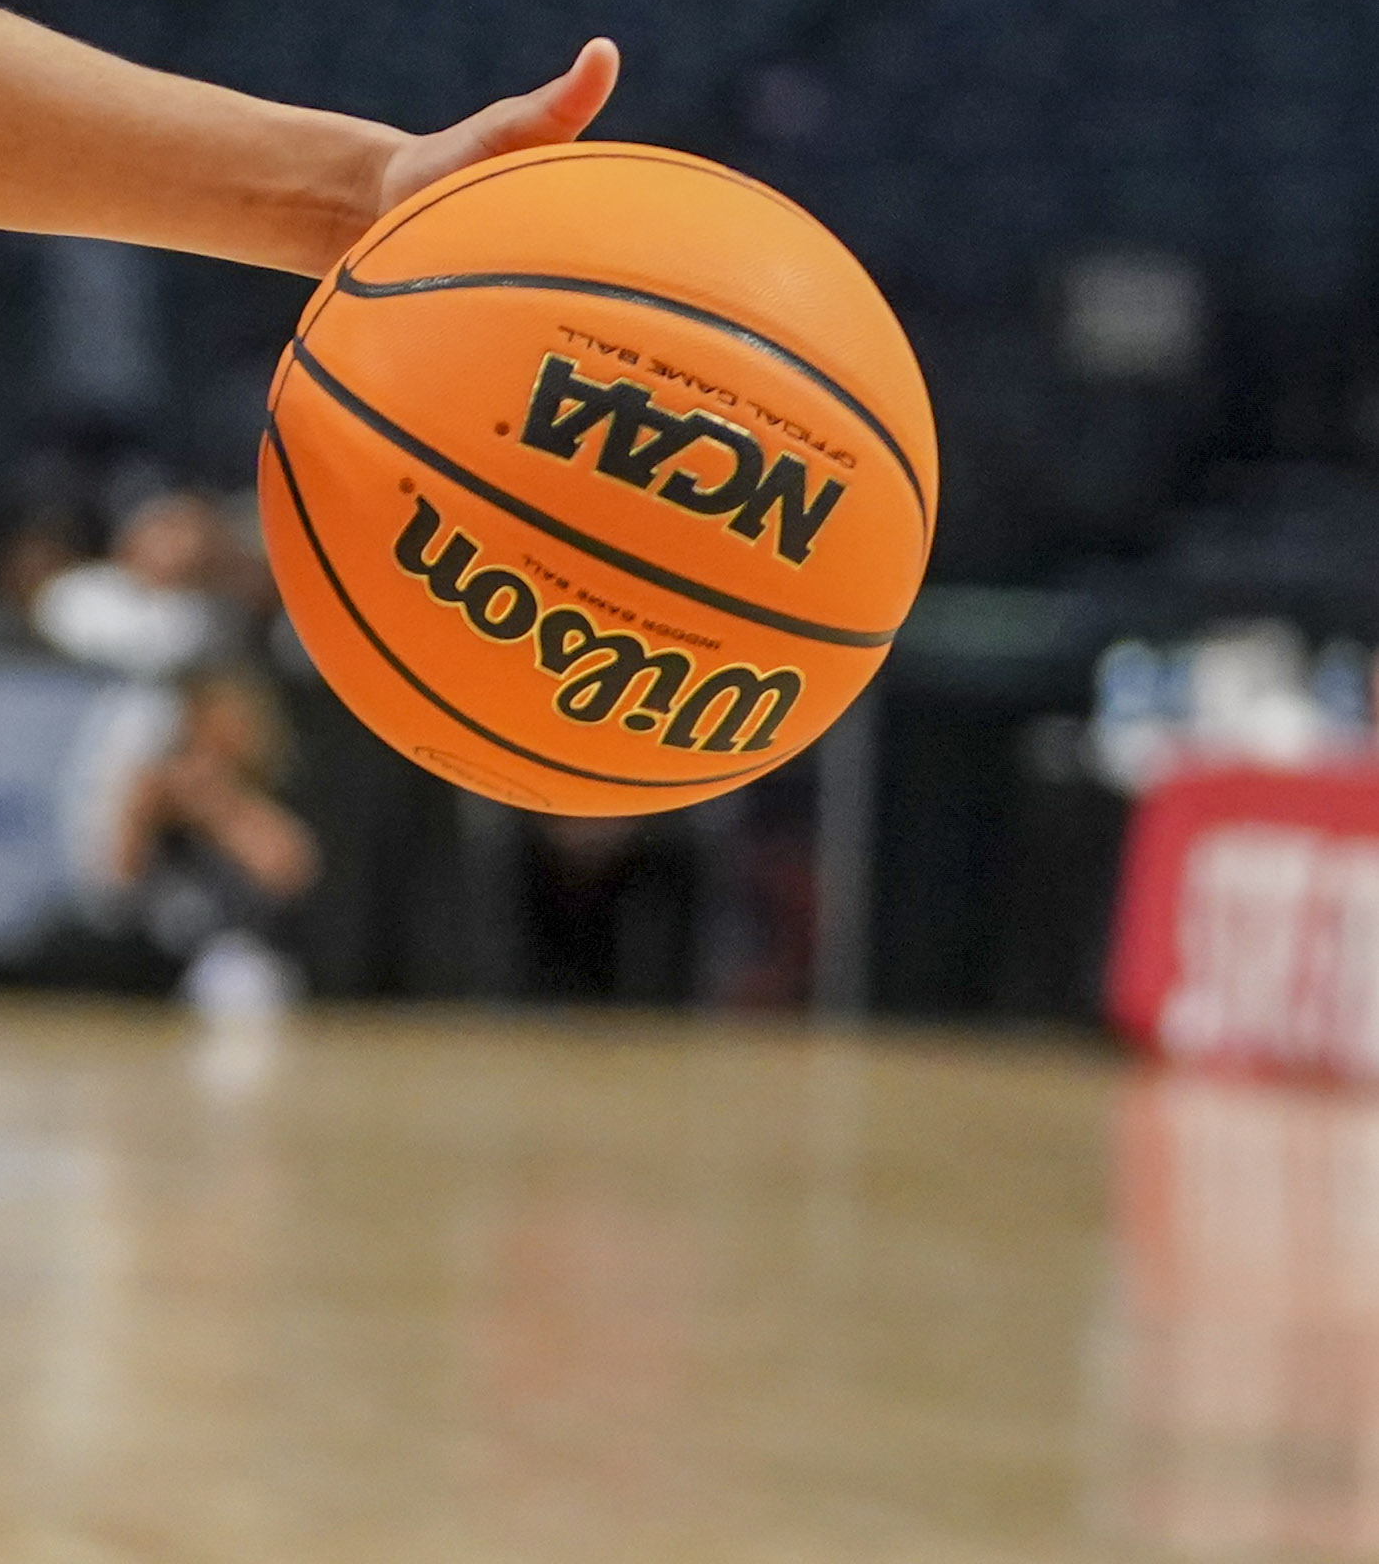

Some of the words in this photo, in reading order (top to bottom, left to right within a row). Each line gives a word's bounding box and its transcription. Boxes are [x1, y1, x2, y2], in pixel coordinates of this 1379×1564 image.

[557, 325, 641, 366] BALL
[647, 358, 738, 407] GAME
[519, 351, 848, 570] NCAA
[747, 399, 856, 470] OFFICIAL
[392, 493, 806, 755] Wilson
